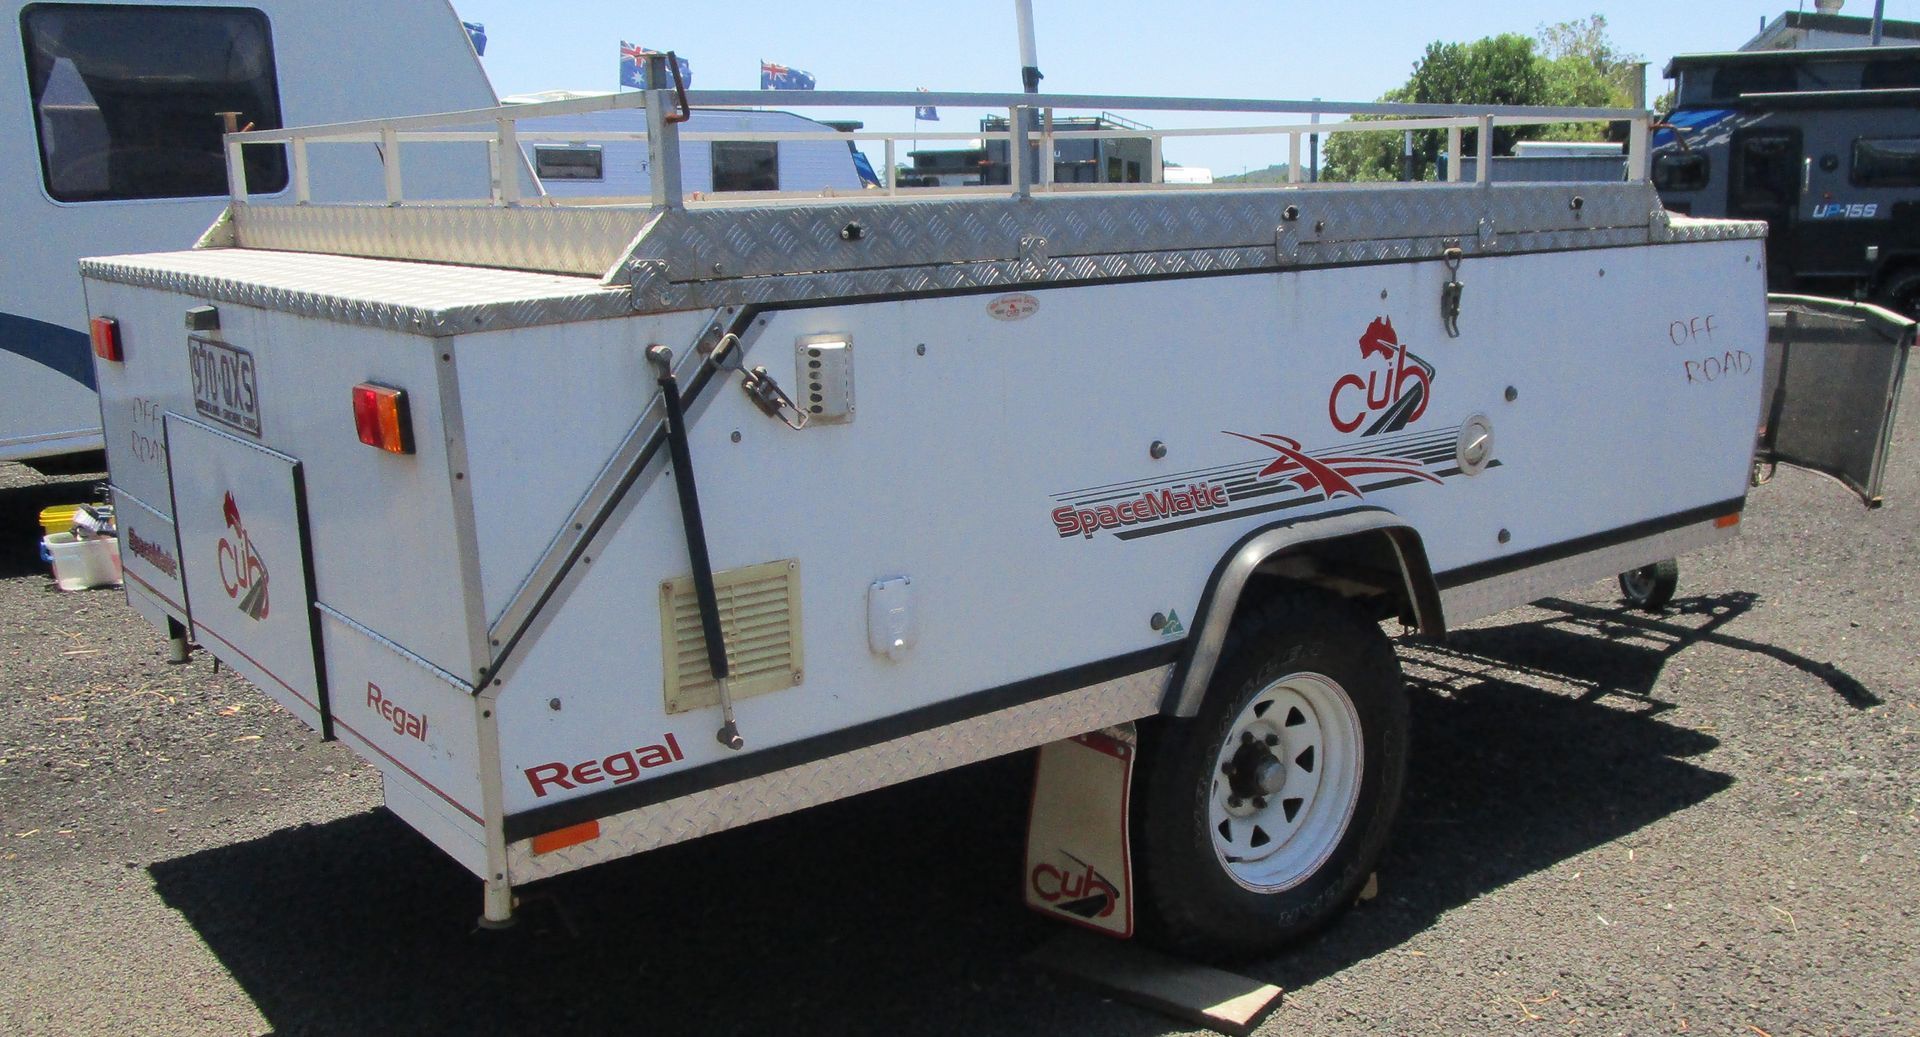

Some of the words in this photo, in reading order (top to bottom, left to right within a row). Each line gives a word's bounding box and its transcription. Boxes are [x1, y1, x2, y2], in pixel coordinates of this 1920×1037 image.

[1669, 315, 1719, 346] OFF
[1684, 350, 1752, 384] ROAD
[1051, 482, 1229, 539] SpaceMatic
[366, 681, 429, 742] Regal
[523, 732, 685, 797] Regal
[1032, 863, 1116, 918] Cub
